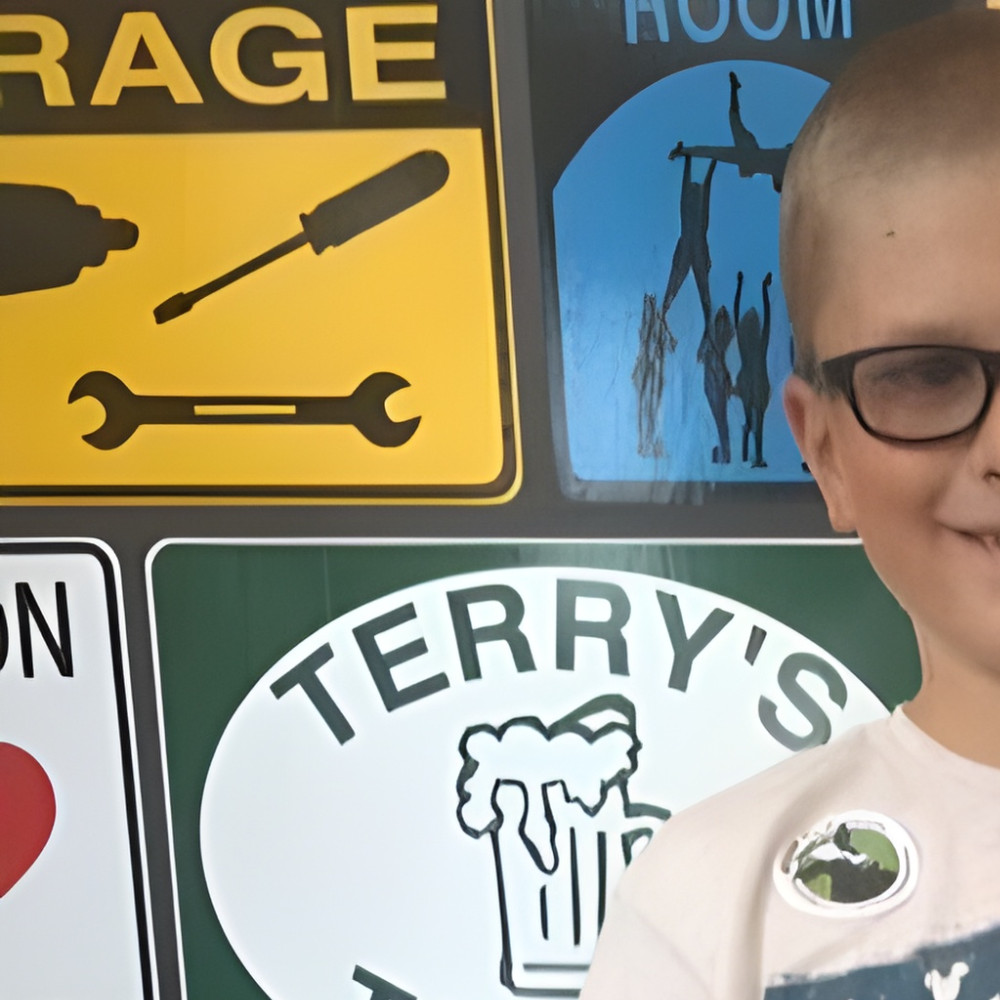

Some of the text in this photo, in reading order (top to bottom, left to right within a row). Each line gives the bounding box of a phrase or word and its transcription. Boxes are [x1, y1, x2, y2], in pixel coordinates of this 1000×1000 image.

[0, 5, 447, 106] RAGE
[0, 581, 74, 678] N
[269, 578, 849, 752] TERRY'S
